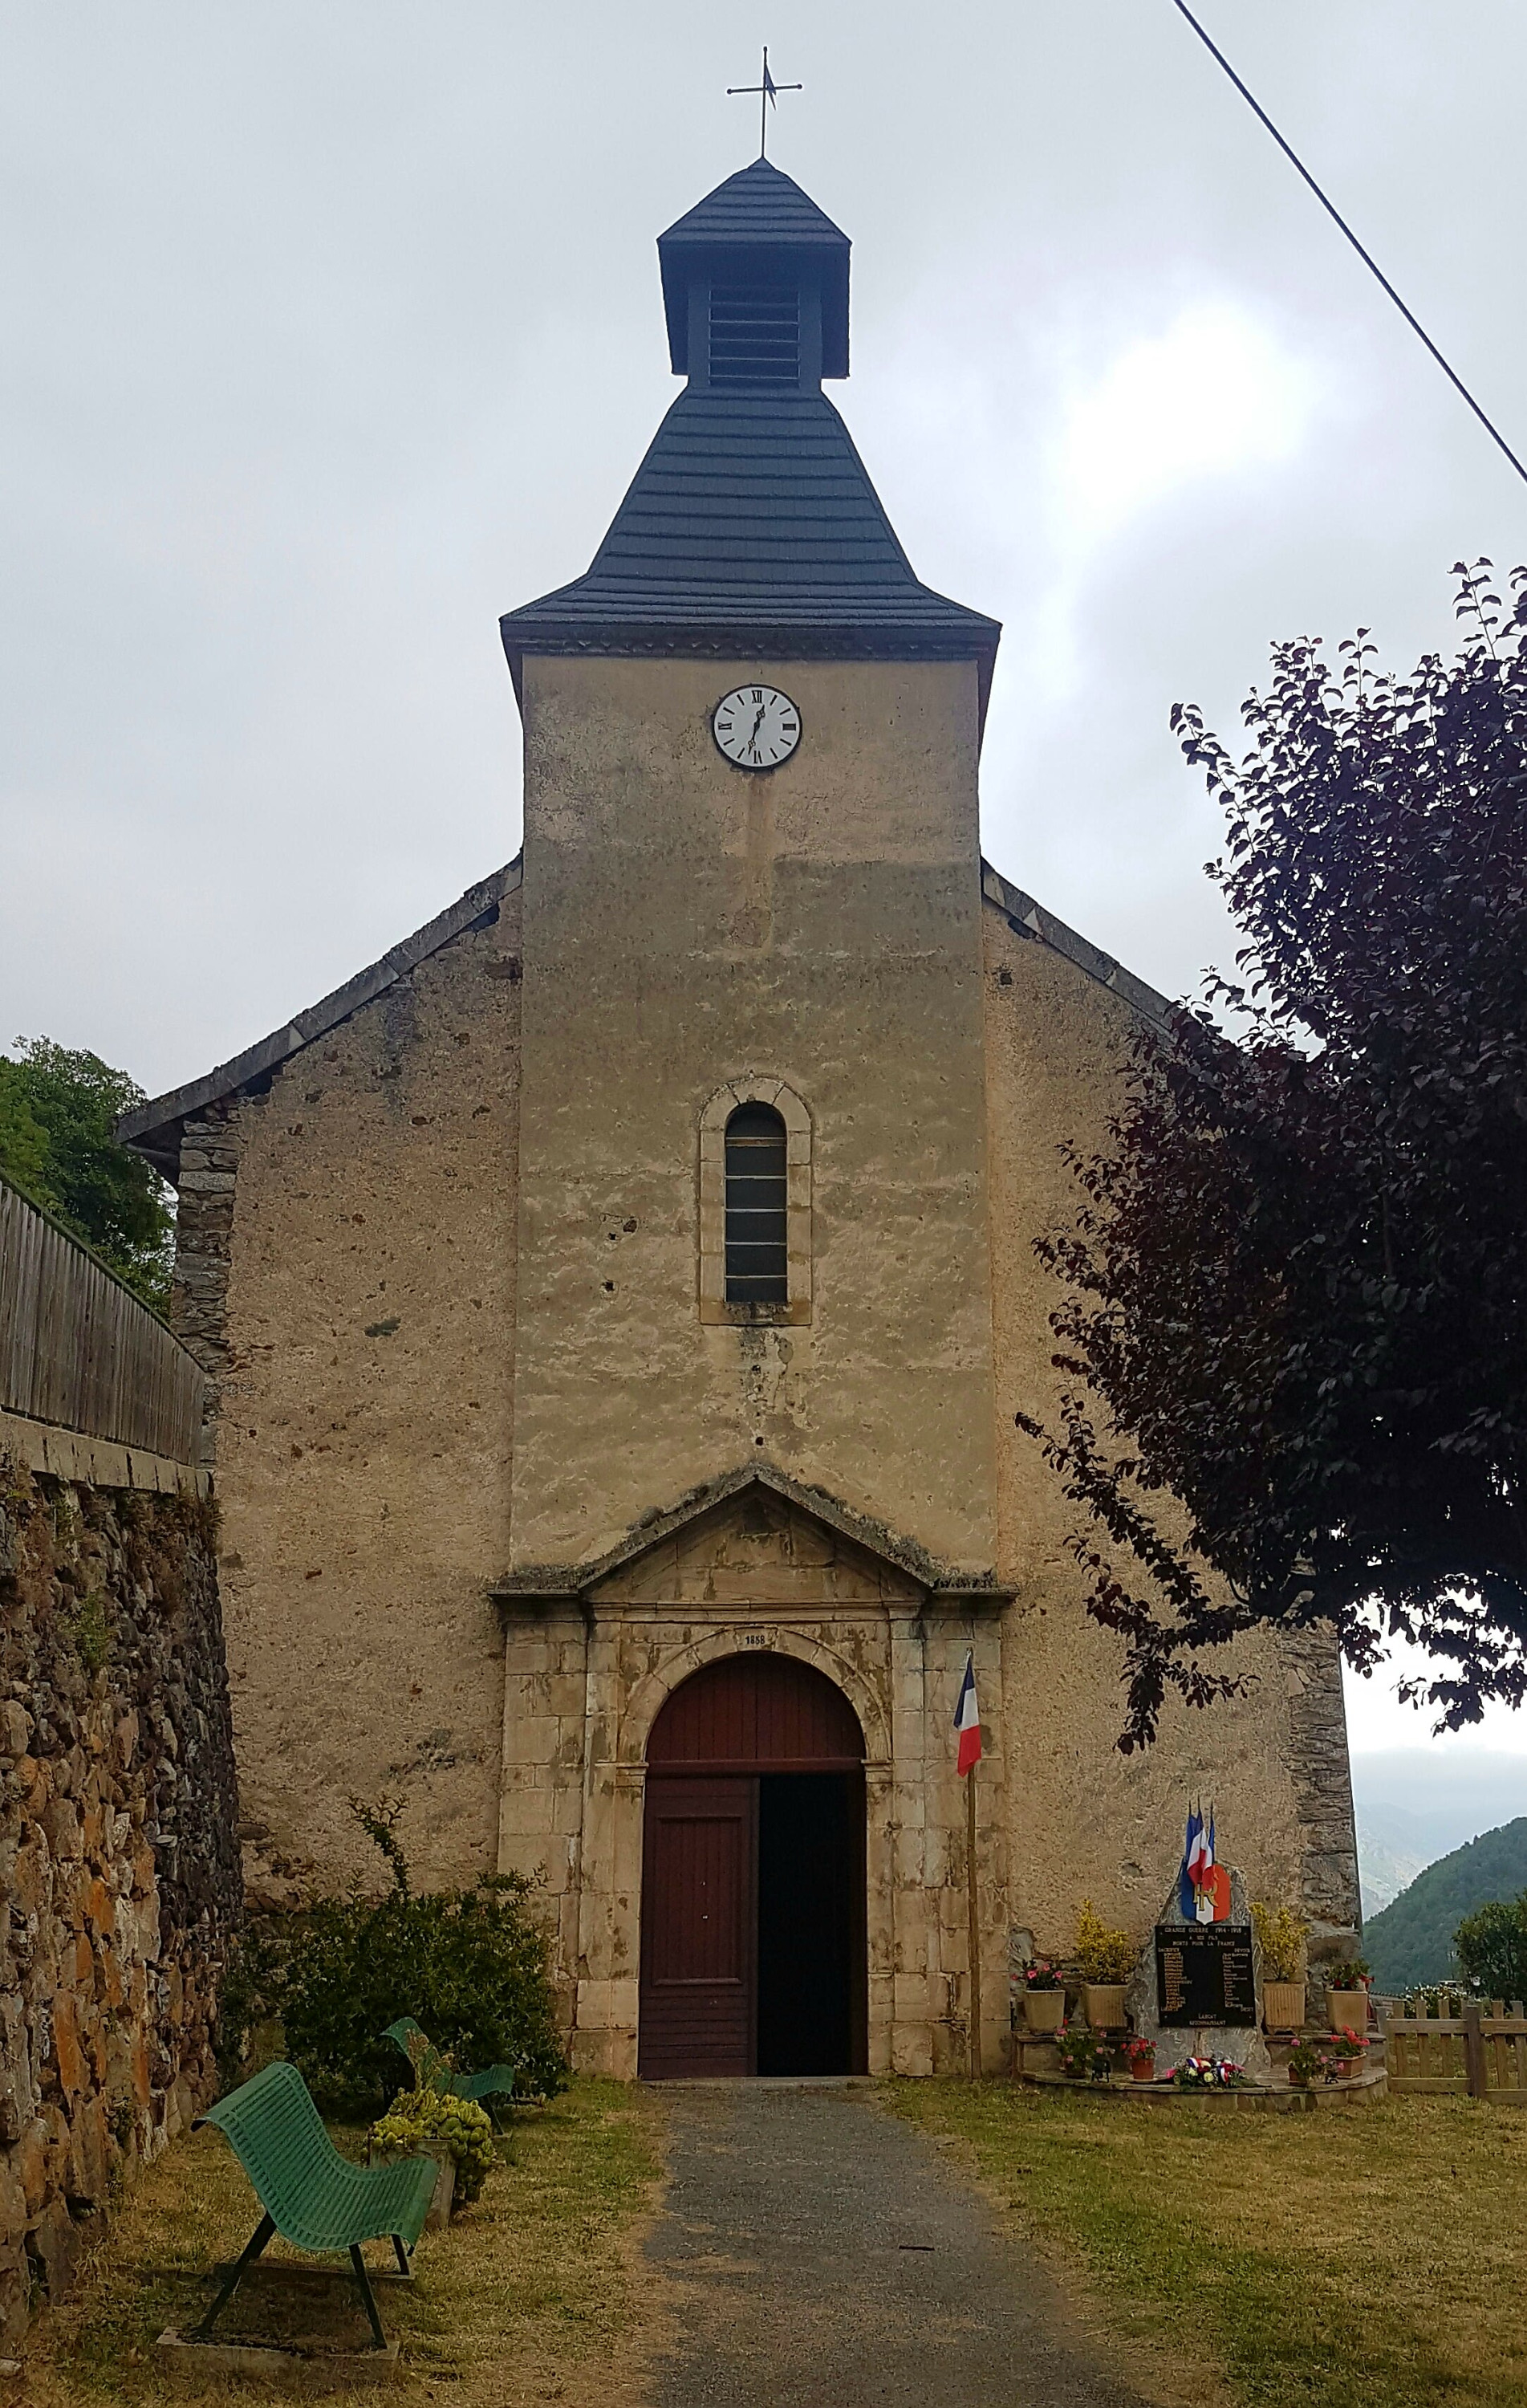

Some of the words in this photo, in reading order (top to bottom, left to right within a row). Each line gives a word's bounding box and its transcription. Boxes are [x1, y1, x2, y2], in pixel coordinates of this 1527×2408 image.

[751, 689, 763, 704] XII
[717, 722, 733, 730] IX
[782, 723, 797, 731] III
